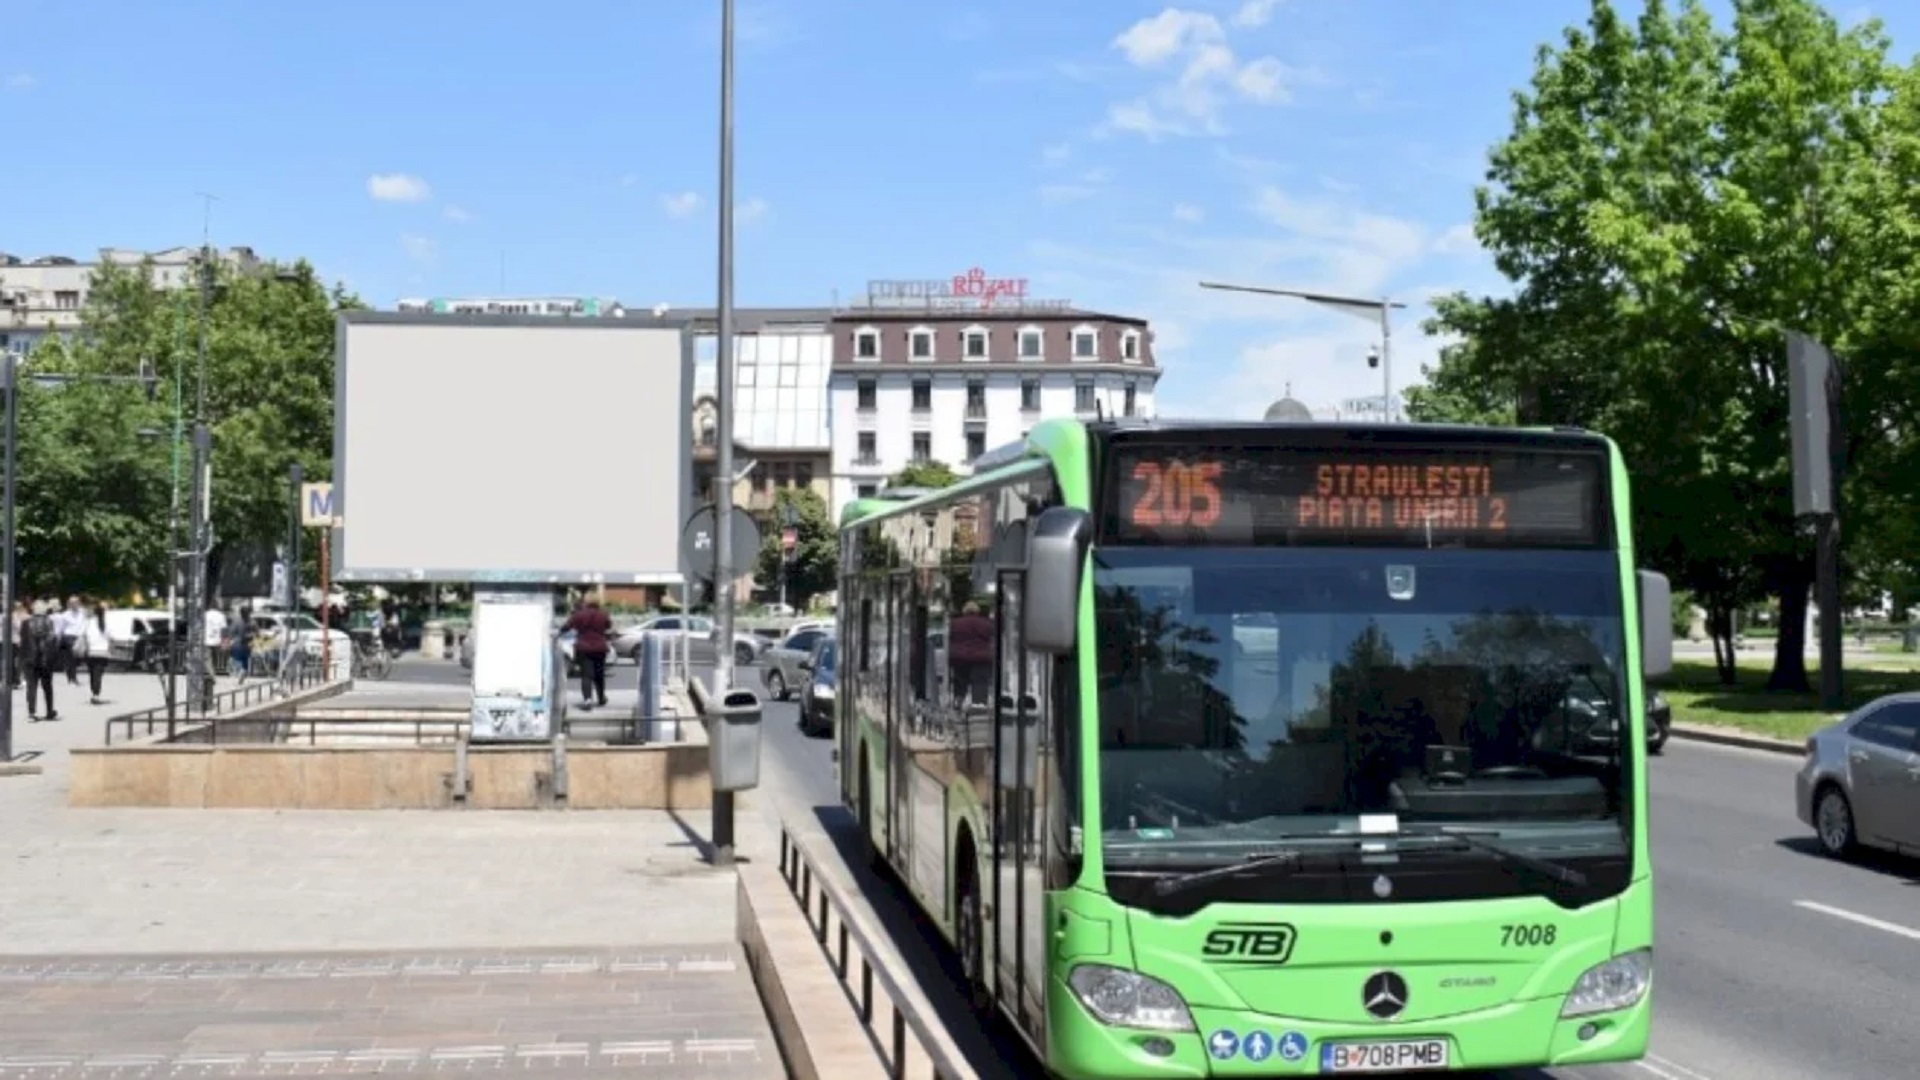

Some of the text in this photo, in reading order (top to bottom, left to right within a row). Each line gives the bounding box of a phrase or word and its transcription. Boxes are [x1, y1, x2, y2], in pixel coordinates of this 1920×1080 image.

[1133, 461, 1221, 526] 205
[1317, 464, 1490, 495] STRAULESTI
[1299, 496, 1382, 527] PIATA
[1490, 498, 1506, 528] 2
[1202, 931, 1287, 955] STB
[1500, 924, 1557, 947] 7008
